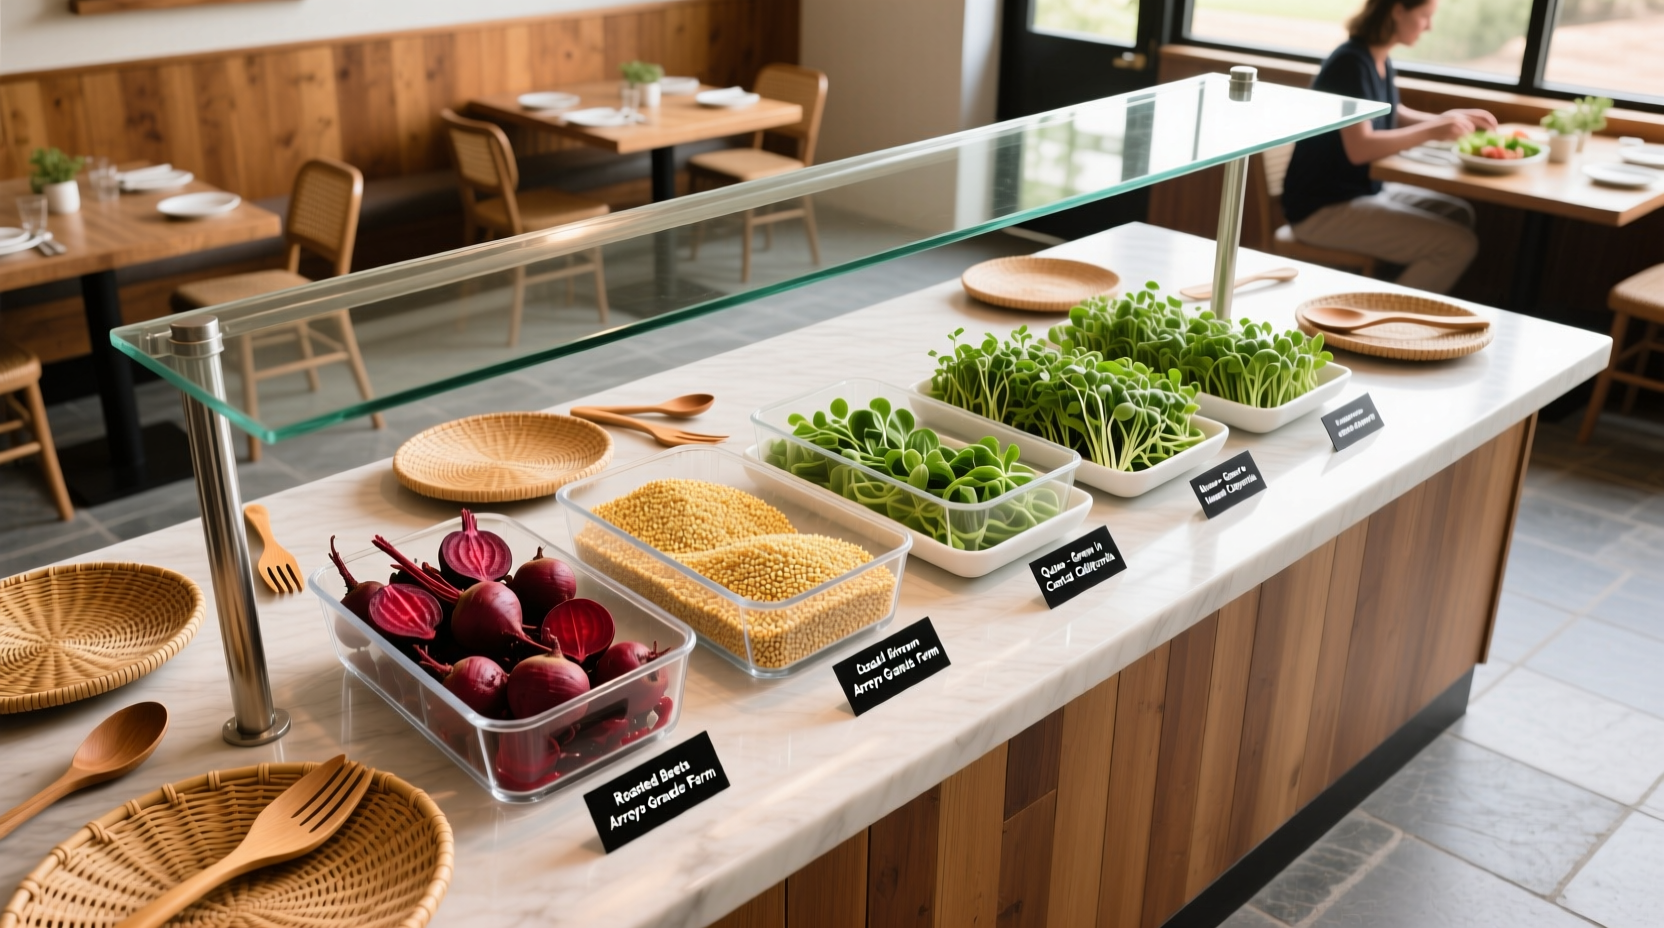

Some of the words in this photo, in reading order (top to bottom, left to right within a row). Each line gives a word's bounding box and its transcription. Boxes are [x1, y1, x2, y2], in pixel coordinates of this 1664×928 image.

[613, 773, 659, 806] Roasted
[660, 760, 691, 783] Beets
[686, 768, 717, 789] Farm
